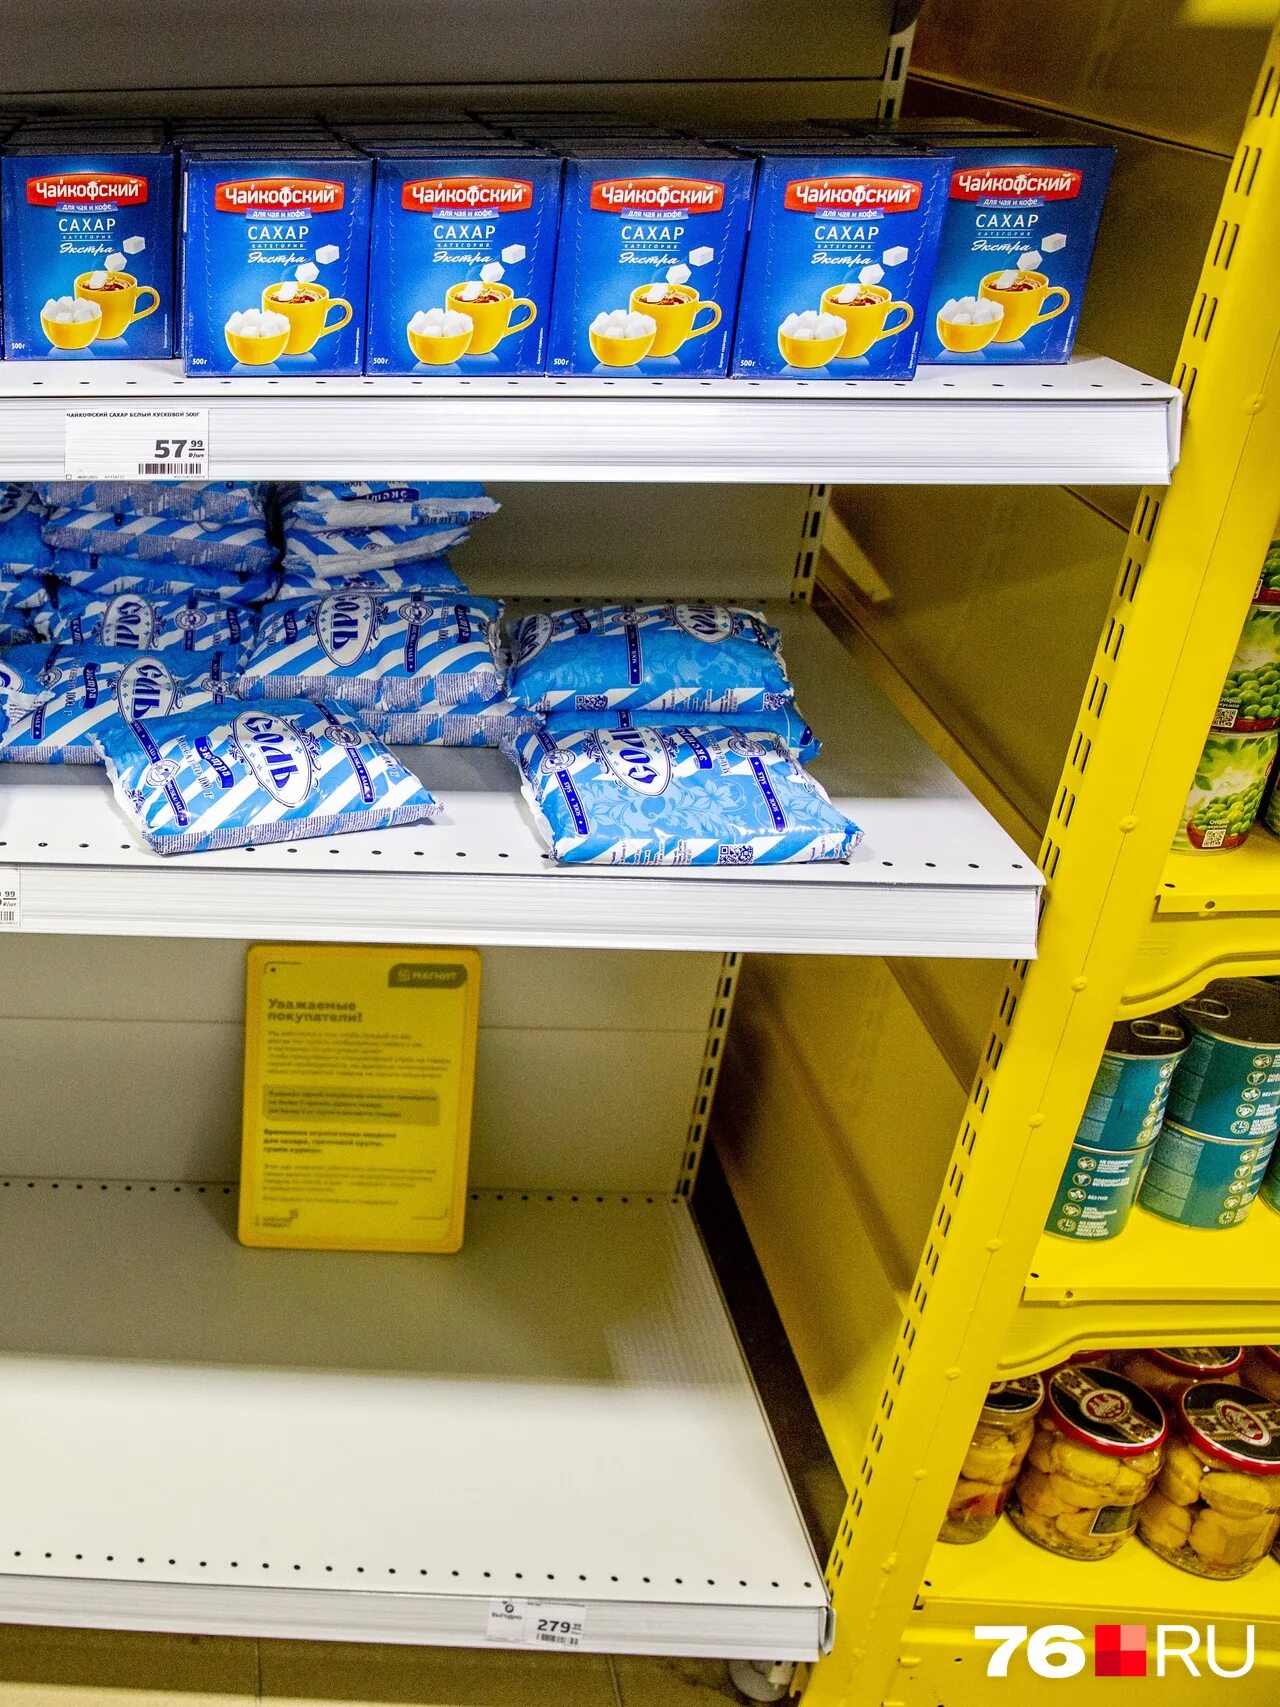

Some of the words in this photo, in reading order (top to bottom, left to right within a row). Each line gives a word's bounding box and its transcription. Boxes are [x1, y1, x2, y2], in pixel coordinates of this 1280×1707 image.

[36, 179, 139, 199] Чайкофский
[959, 172, 1071, 194] Чайкофский
[225, 185, 334, 206] Чайкофский
[412, 184, 523, 205] Чайкофский
[602, 185, 714, 206] Чайкофский
[796, 184, 911, 206] Чайкофский
[59, 219, 115, 231] САХАР
[976, 214, 1039, 228] САХАР
[248, 226, 309, 239] САХАР
[434, 226, 495, 239] САХАР
[622, 226, 684, 240] САХАР
[814, 226, 879, 240] САХАР
[60, 243, 115, 256] Экстра
[972, 240, 1031, 254] Экстра
[248, 252, 307, 266] Экстра
[433, 251, 493, 265] Экстра
[619, 252, 680, 266] Экстра
[811, 253, 873, 267] Экстра
[154, 440, 187, 458] 57
[331, 595, 360, 650] ОЛЬ
[268, 998, 357, 1012] Уважаемые
[267, 1010, 363, 1025] покупатели!
[537, 1619, 571, 1634] 279
